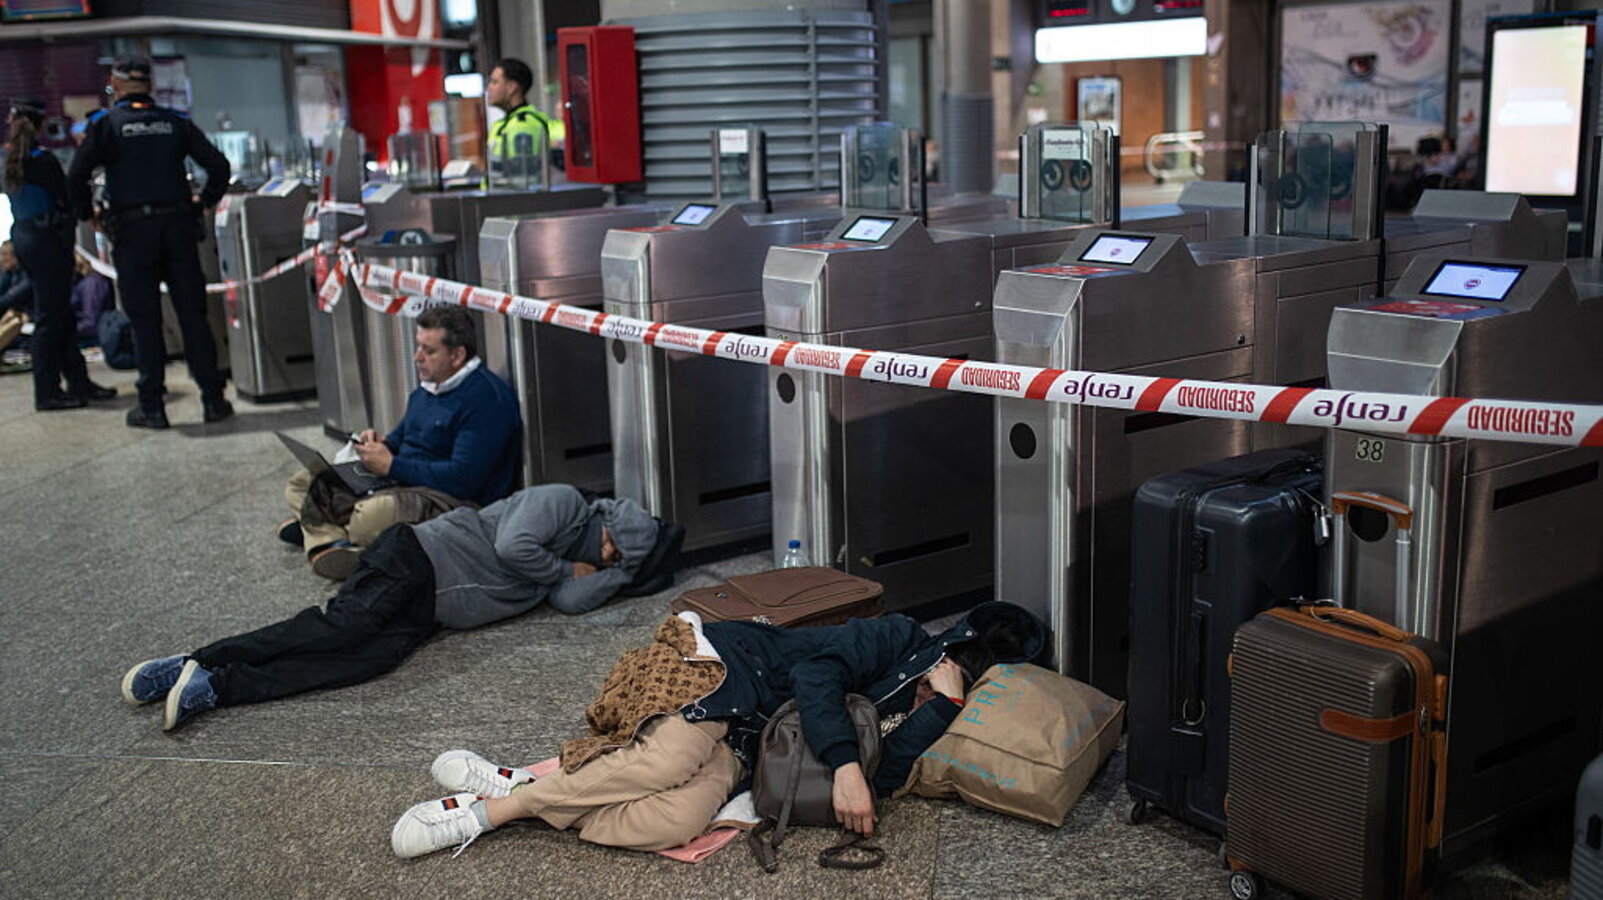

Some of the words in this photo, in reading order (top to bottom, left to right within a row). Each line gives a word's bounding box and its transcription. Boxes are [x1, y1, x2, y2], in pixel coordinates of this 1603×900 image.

[725, 336, 768, 359] renfe
[874, 357, 928, 381] renfe
[961, 366, 1020, 391] SEGURIDAD
[1064, 373, 1134, 403] renfe
[1177, 386, 1256, 413] SEGURIDAD
[1313, 393, 1408, 425] renfe
[1467, 405, 1575, 437] SEGURIDAD
[1357, 439, 1384, 462] 38
